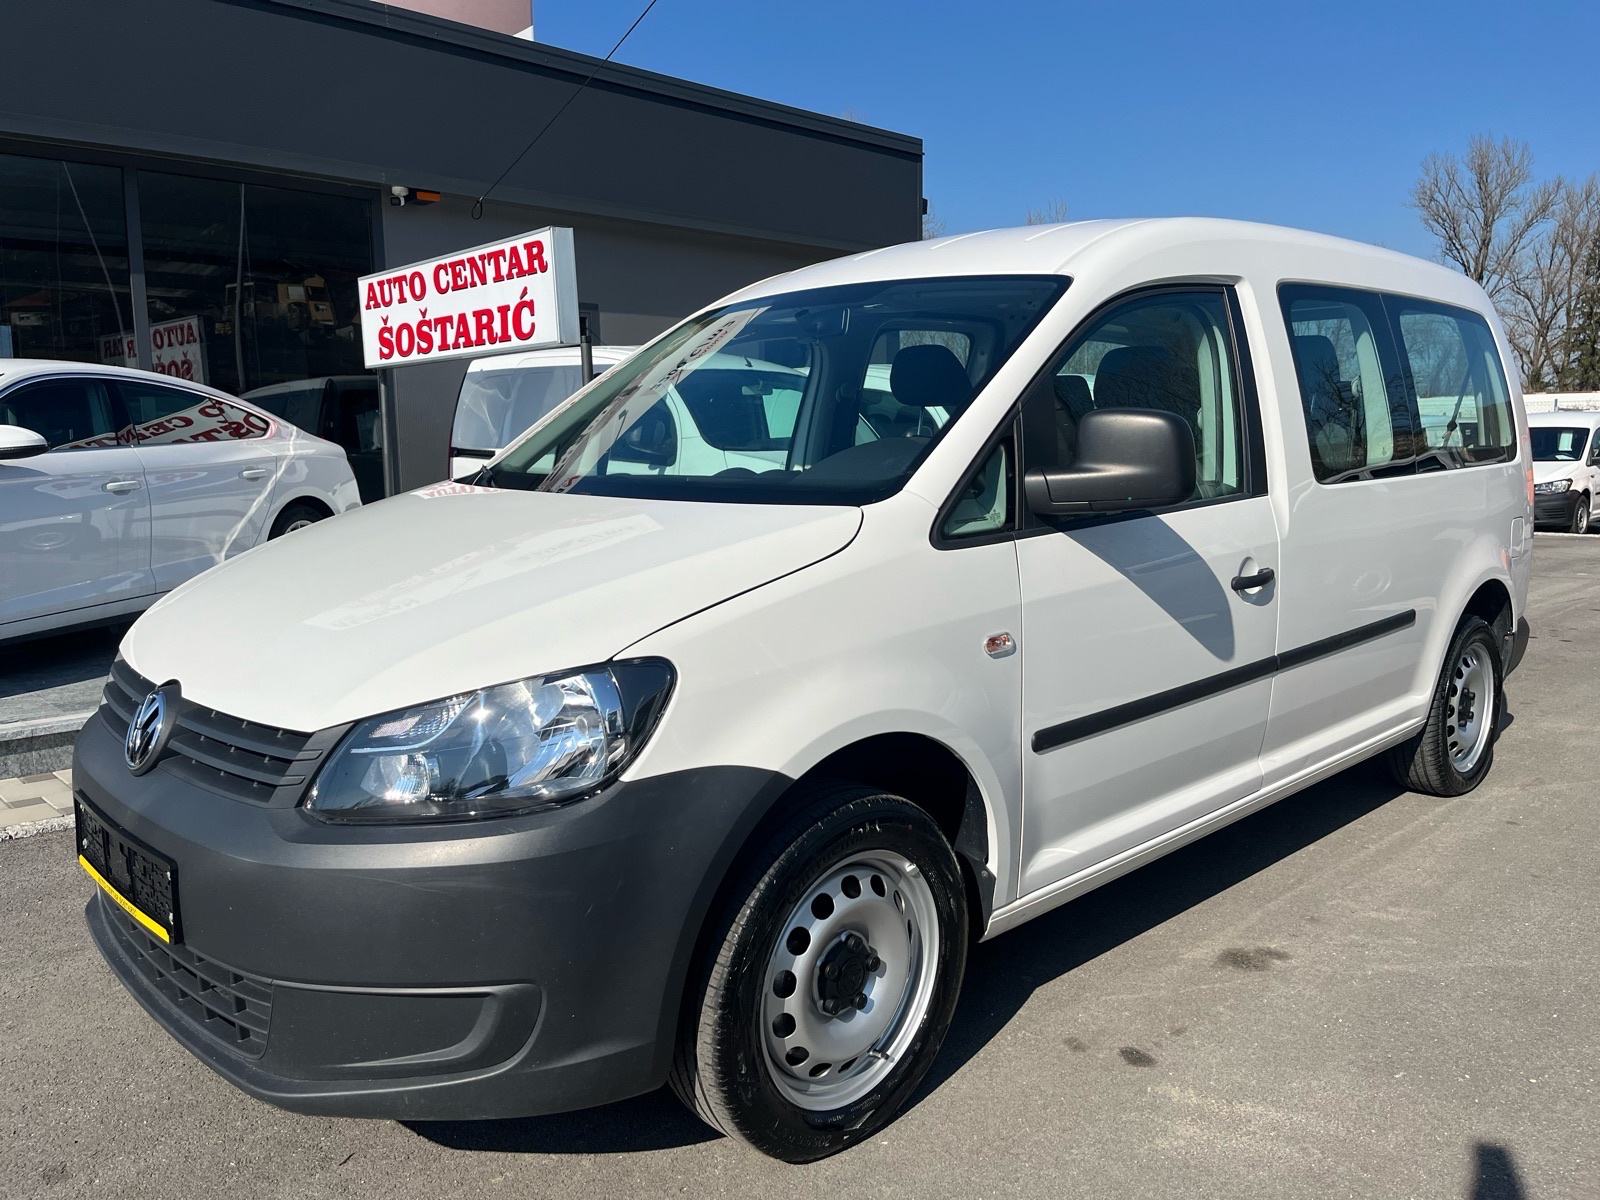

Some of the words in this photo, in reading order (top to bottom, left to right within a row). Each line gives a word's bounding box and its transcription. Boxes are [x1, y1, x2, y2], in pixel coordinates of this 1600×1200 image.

[365, 271, 427, 311] AUTO
[433, 240, 548, 294] CENTAR
[378, 286, 536, 360] ŠOŠTARIĆ
